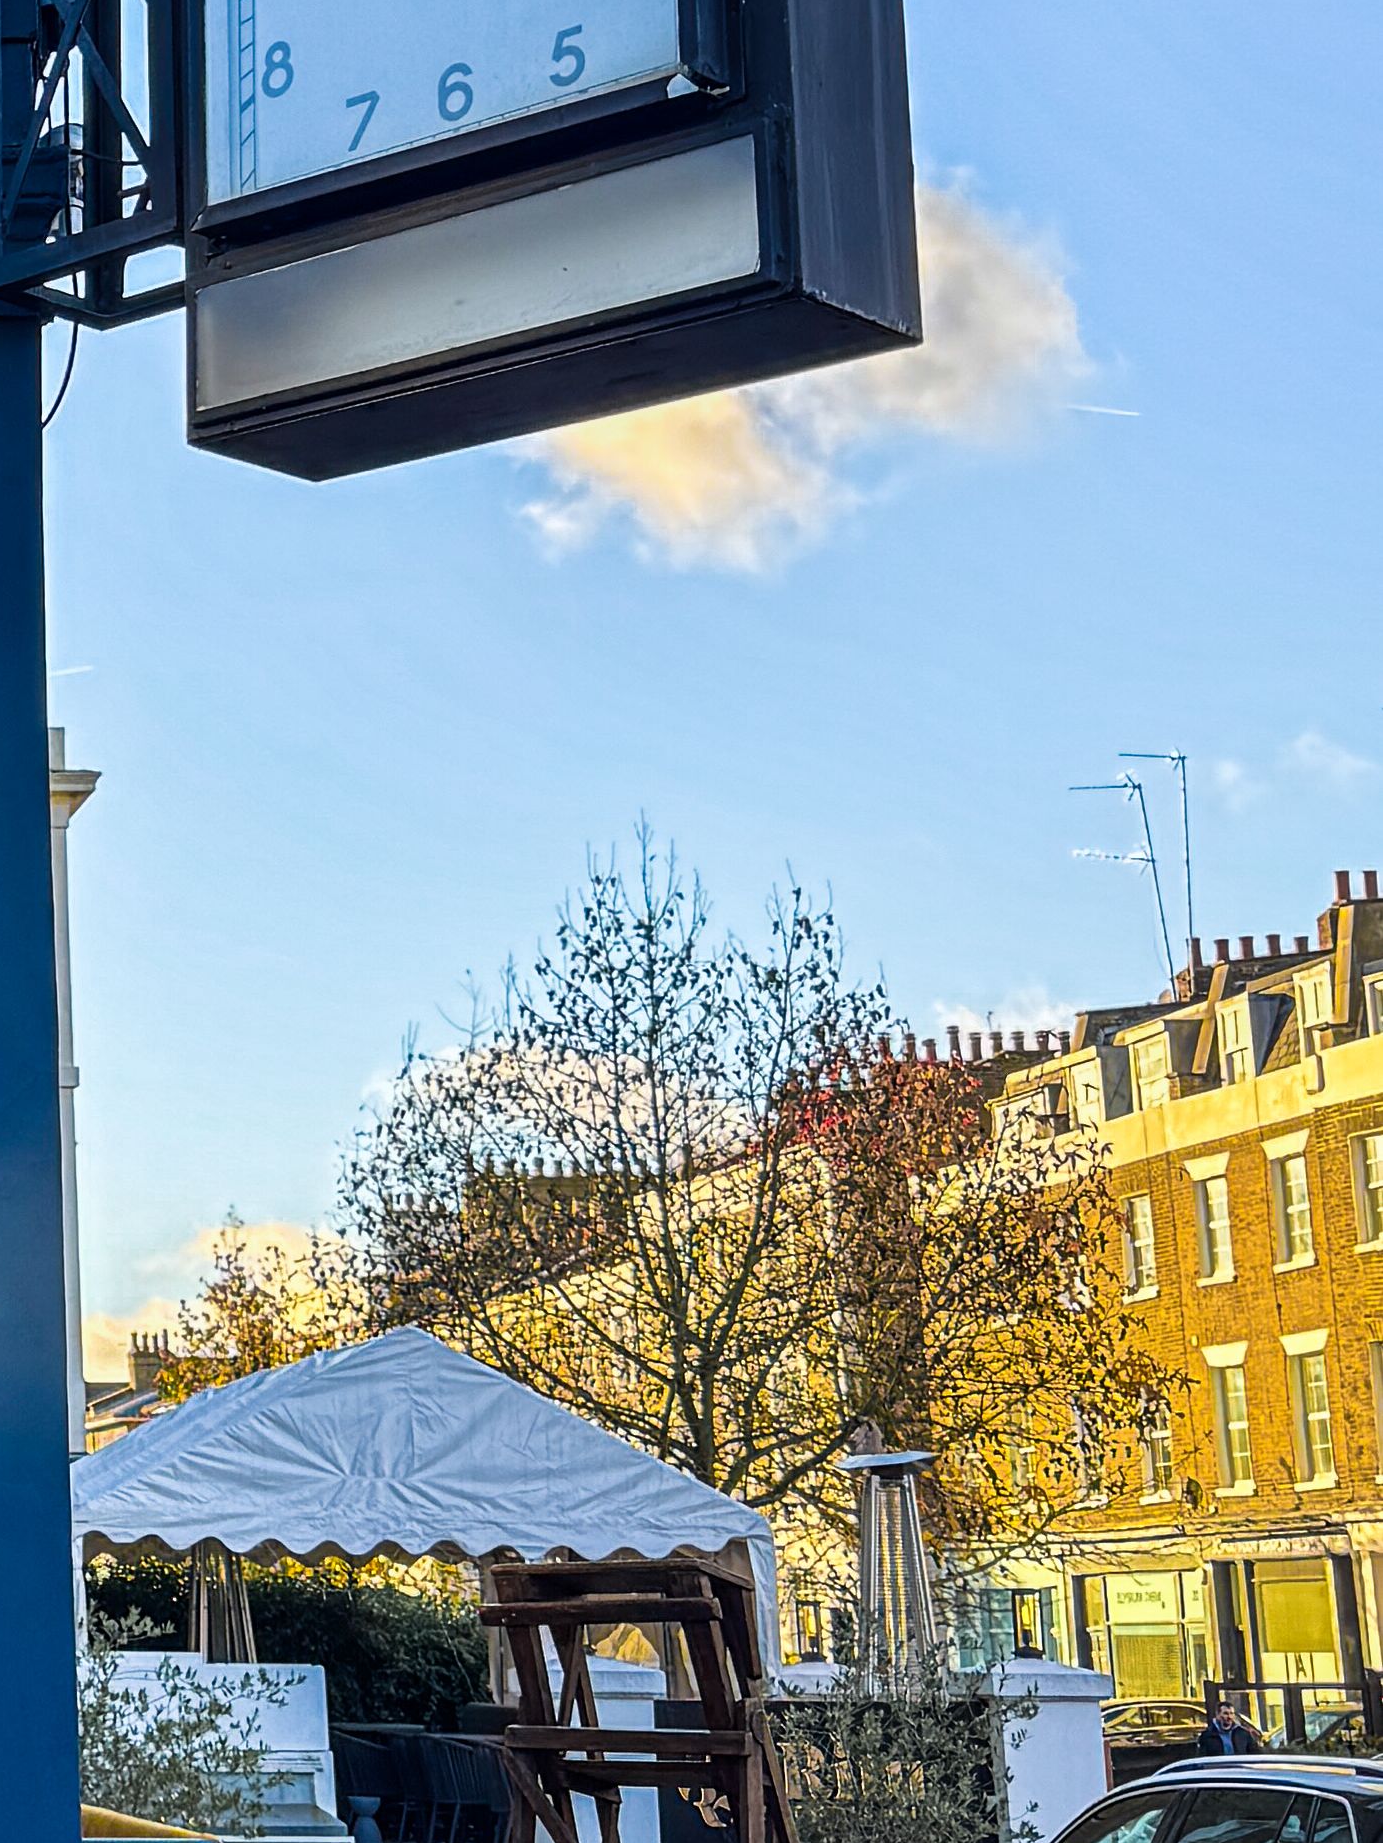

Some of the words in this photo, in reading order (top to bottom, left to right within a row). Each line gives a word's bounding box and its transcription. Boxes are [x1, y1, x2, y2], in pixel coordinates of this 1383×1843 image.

[261, 40, 295, 99] 8
[549, 24, 587, 88] 5
[345, 90, 381, 153] 7
[438, 62, 475, 122] 6
